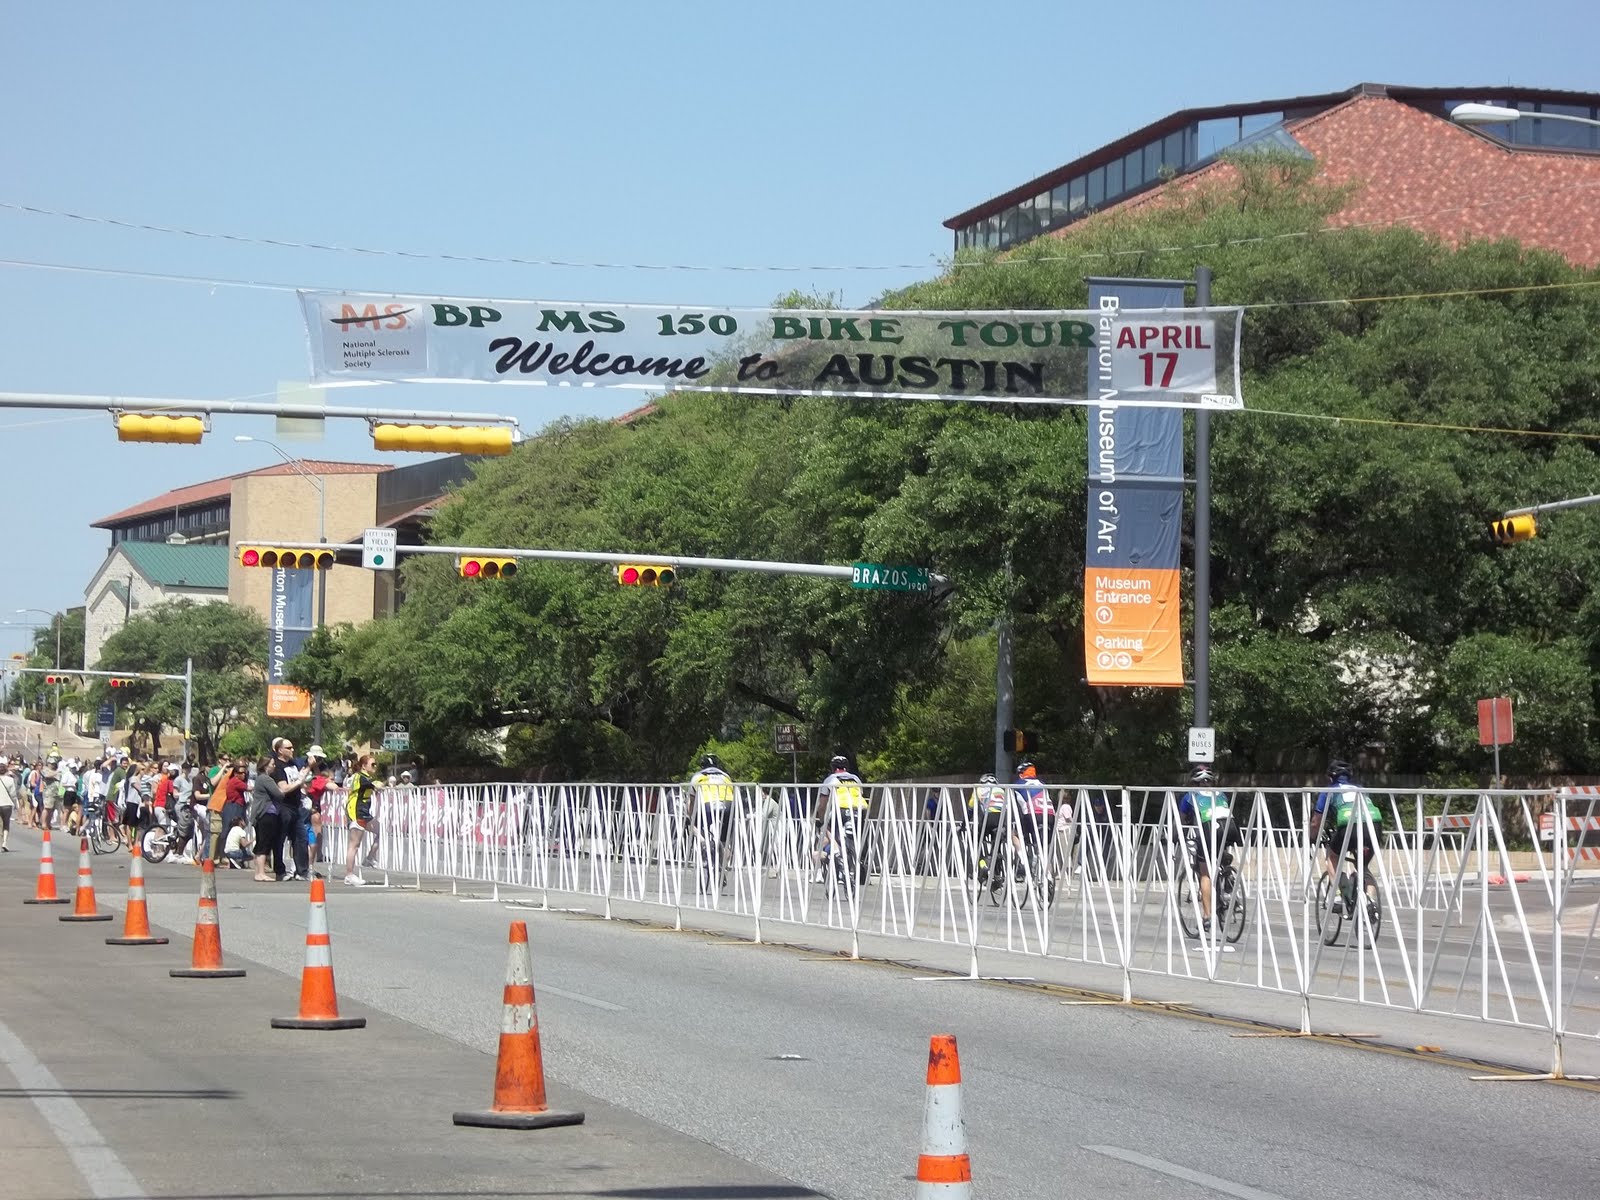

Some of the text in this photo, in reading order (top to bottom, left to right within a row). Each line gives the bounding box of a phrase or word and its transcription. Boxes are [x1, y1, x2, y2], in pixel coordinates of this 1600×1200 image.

[341, 303, 407, 332] MS
[430, 303, 1097, 348] BP MS 150 BIKE TOUR
[342, 340, 376, 349] National
[1116, 325, 1211, 349] APRIL
[343, 348, 410, 359] Multiple Sclerosis
[344, 360, 372, 368] Society
[488, 336, 1046, 394] Welcome to AUSTIN
[1138, 352, 1179, 388] 17
[1099, 388, 1119, 484] Museum
[1098, 491, 1118, 515] of
[371, 538, 389, 546] YIELD
[1097, 518, 1117, 554] Art
[853, 567, 929, 585] BRAZOS ST
[1095, 575, 1151, 590] Museum
[1095, 590, 1152, 604] Entrance
[275, 595, 287, 643] Museum
[274, 645, 285, 659] of
[1095, 635, 1144, 652] Parking
[273, 660, 285, 677] Art
[1191, 740, 1212, 748] BUSES
